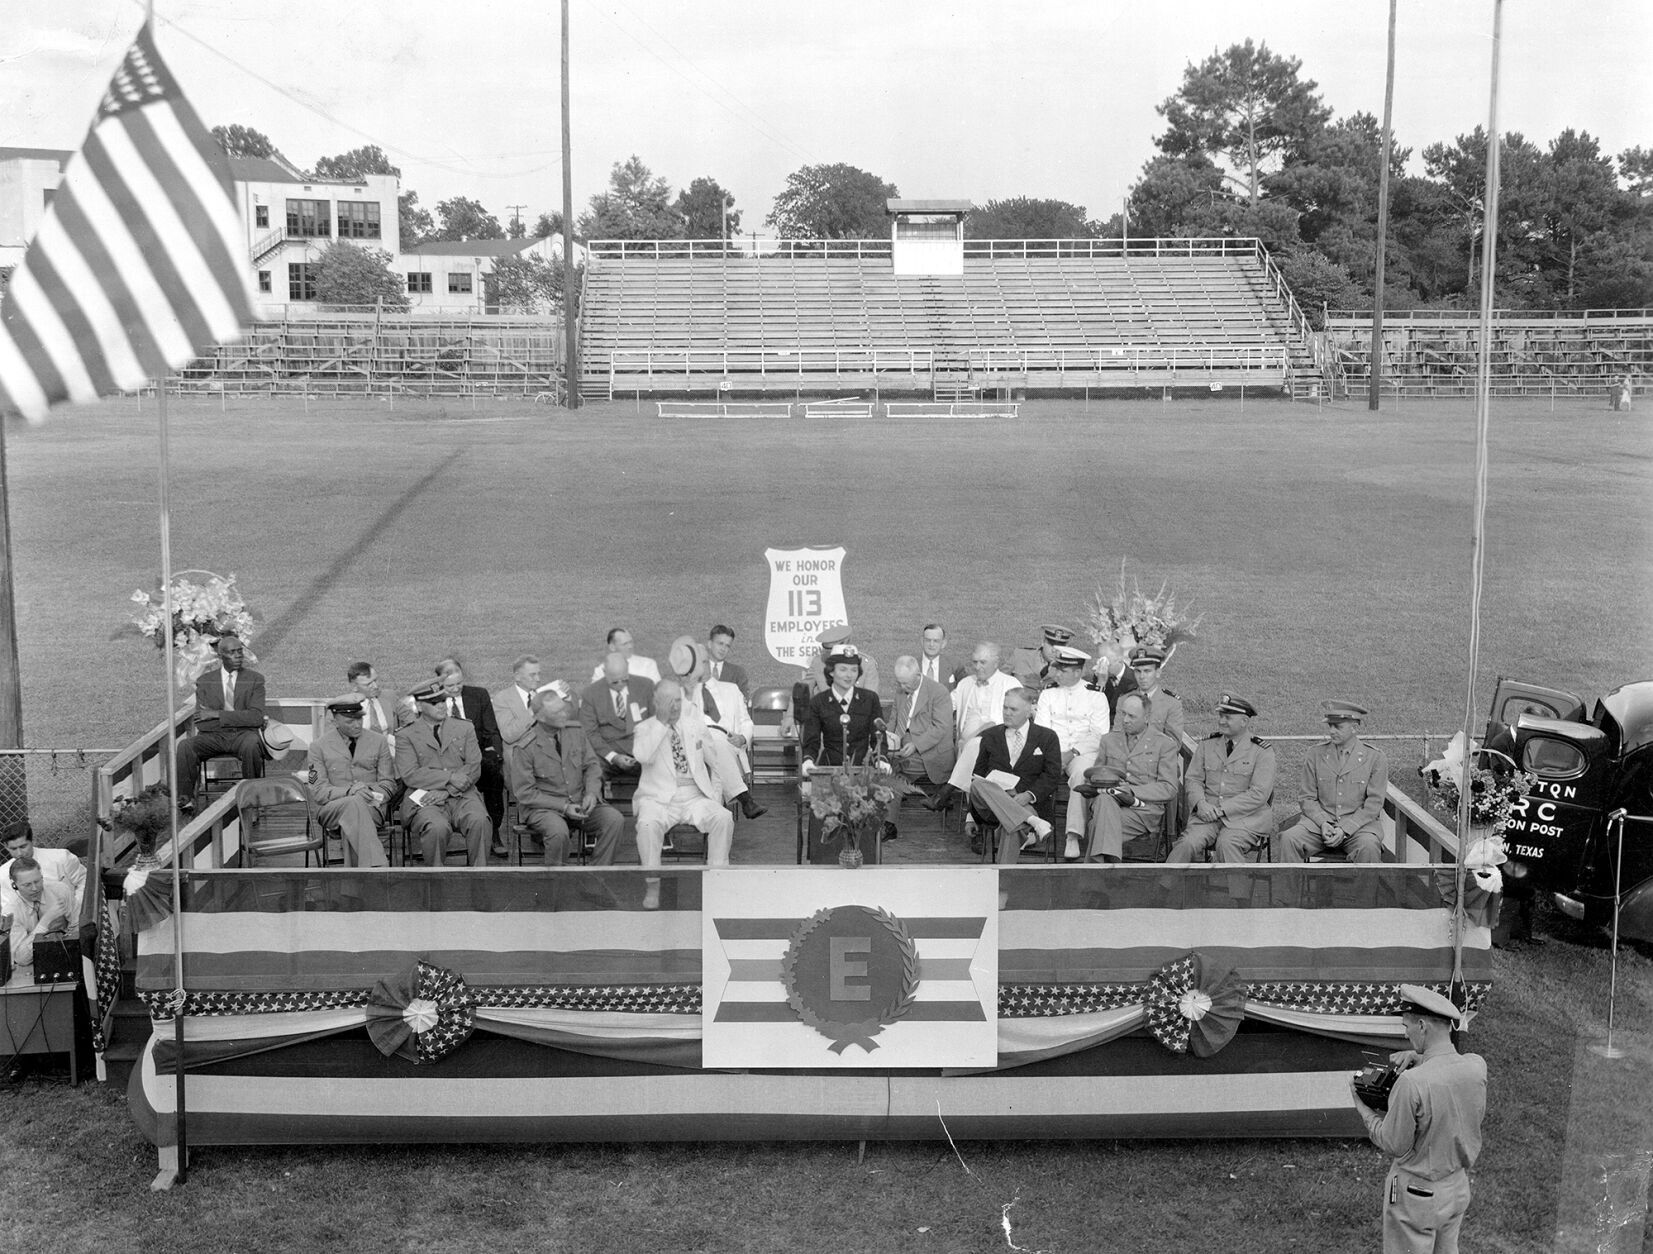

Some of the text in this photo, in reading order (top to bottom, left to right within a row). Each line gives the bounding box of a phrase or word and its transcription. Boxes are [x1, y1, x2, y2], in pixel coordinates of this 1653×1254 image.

[775, 560, 836, 572] WE HONOR
[792, 574, 818, 586] OUR
[788, 590, 822, 616] 113
[801, 632, 815, 643] in
[775, 646, 795, 657] THE
[1529, 822, 1564, 838] POST
[1515, 844, 1545, 858] TEXAS
[830, 936, 871, 1001] E
